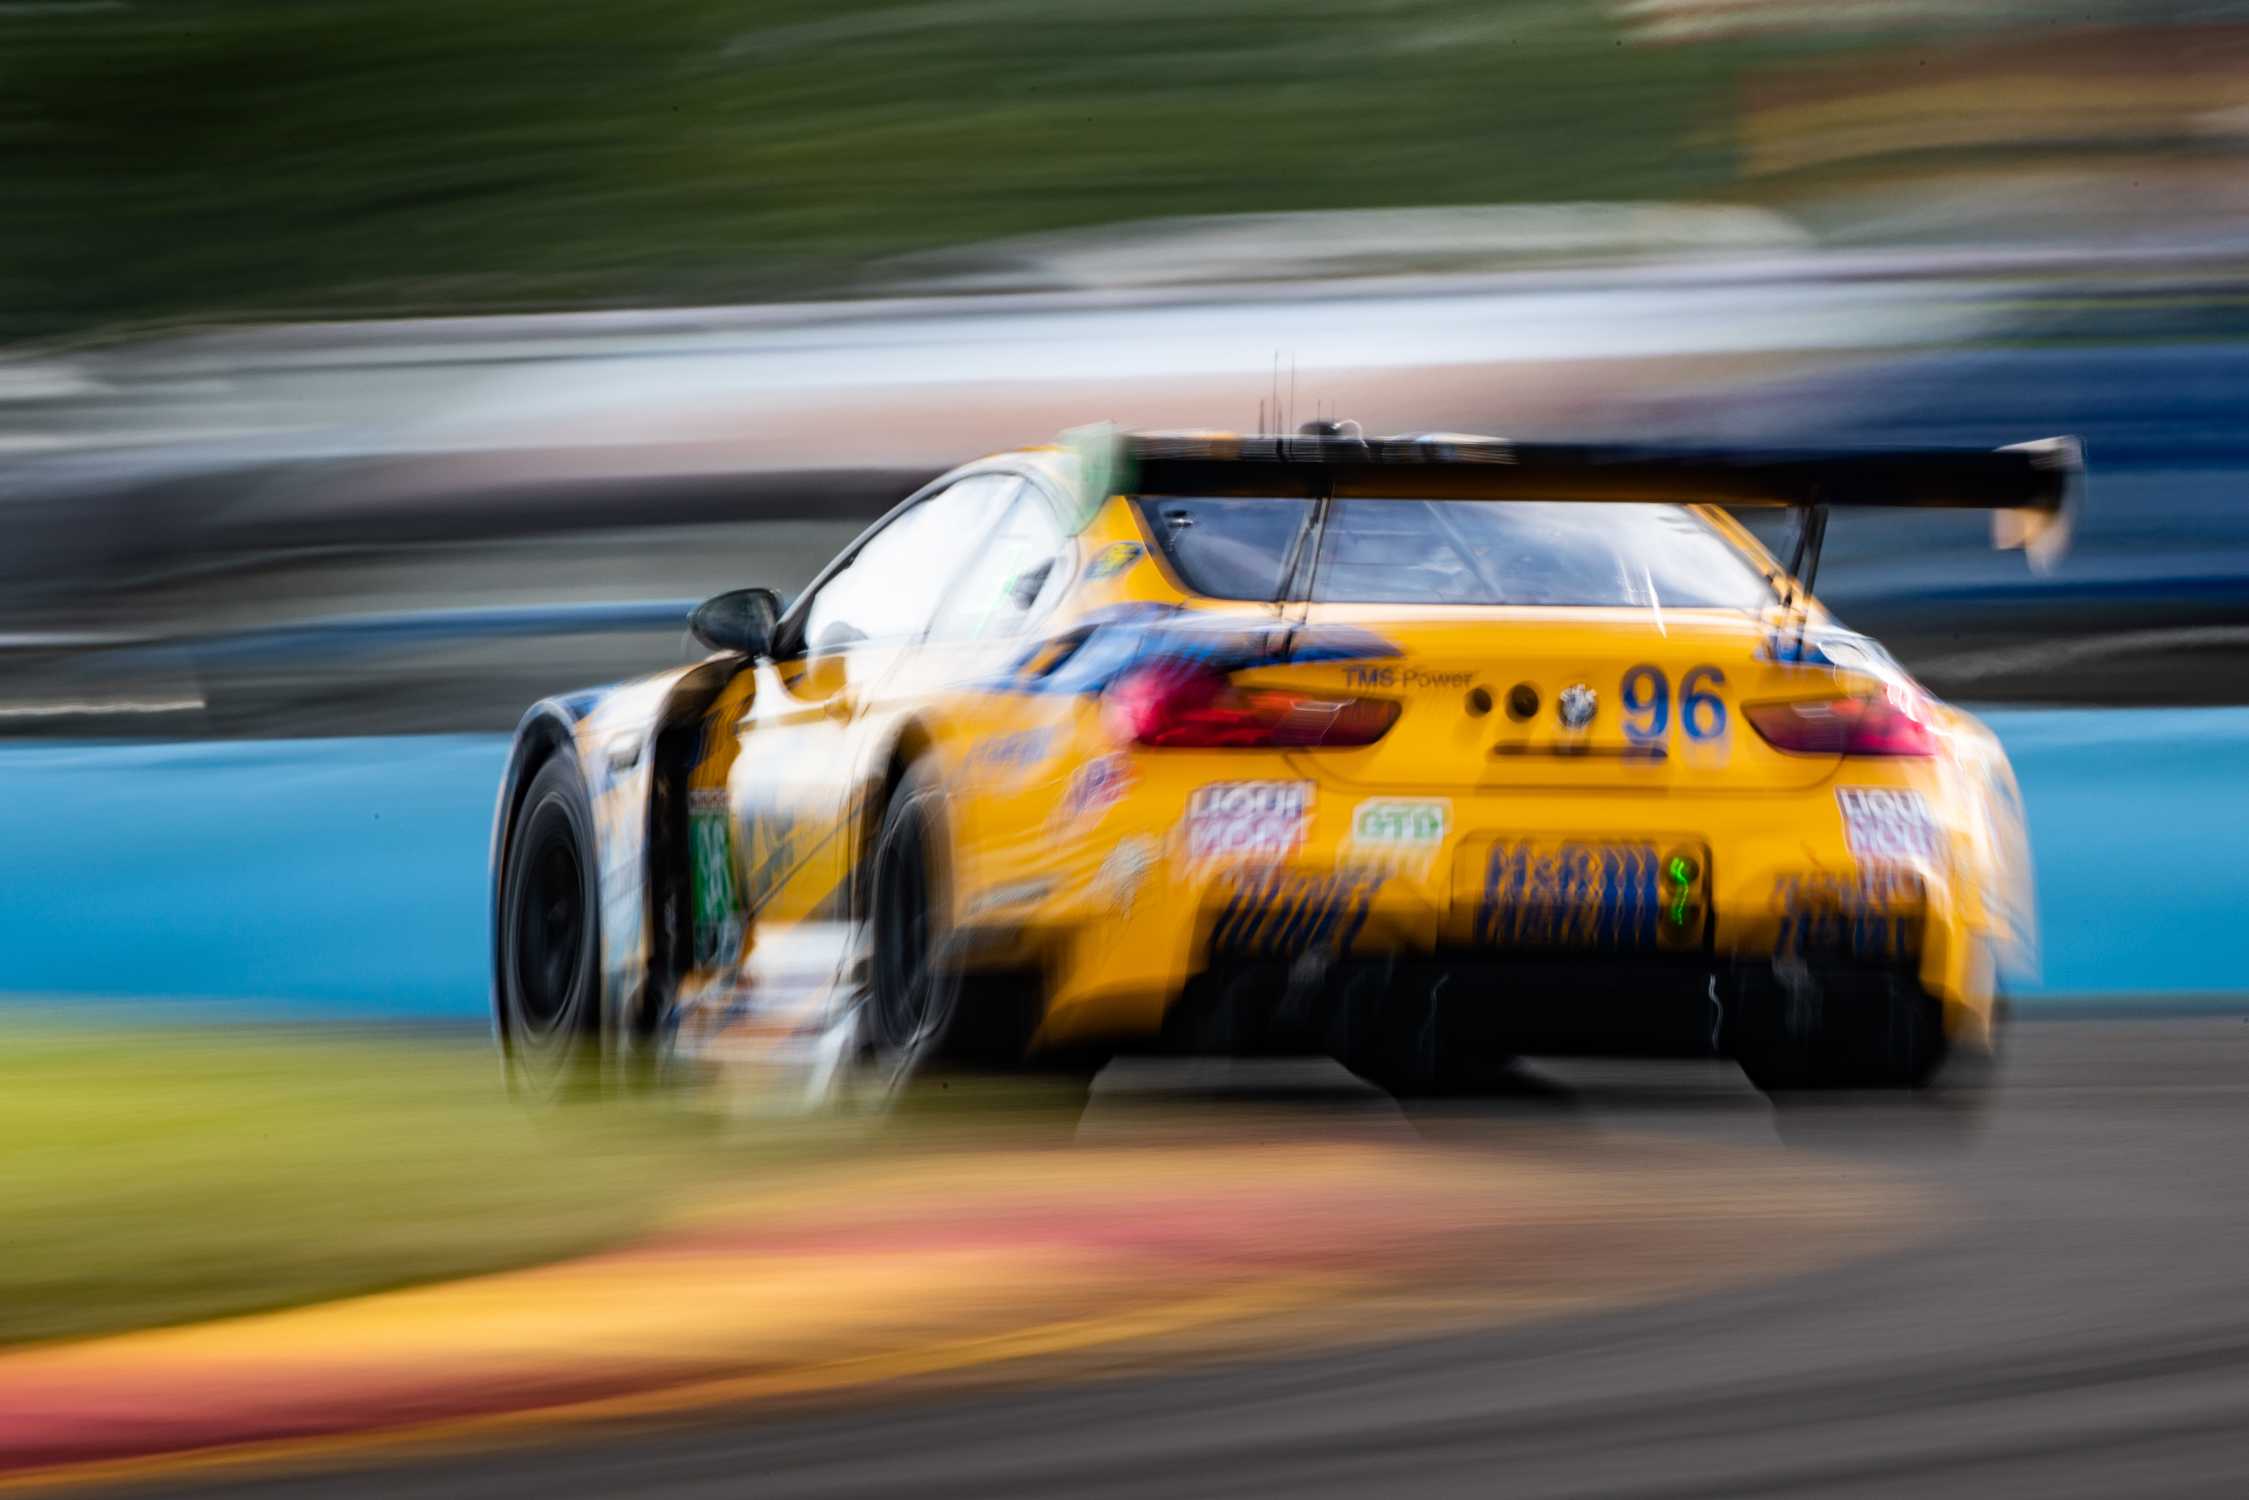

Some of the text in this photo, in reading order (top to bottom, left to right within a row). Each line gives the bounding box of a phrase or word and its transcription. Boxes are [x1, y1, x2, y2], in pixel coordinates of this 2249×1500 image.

[1343, 665, 1473, 687] TMS Power
[1621, 664, 1726, 742] 96
